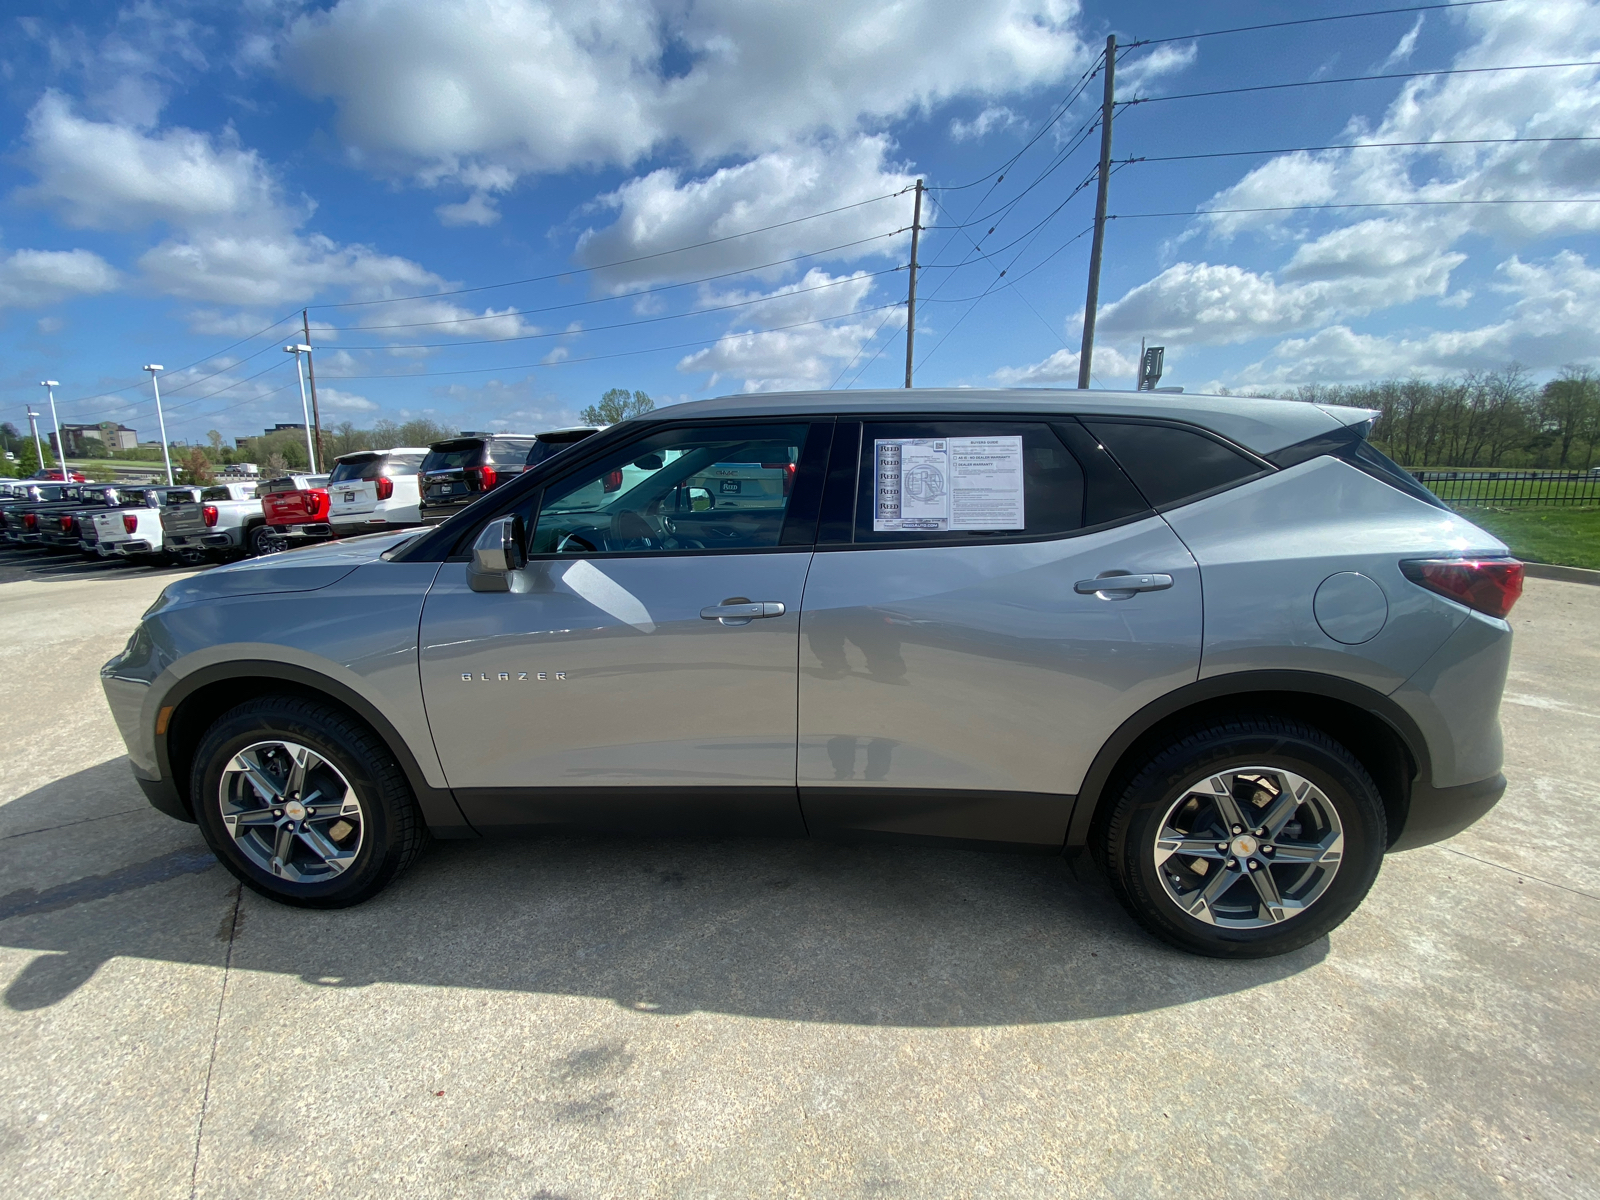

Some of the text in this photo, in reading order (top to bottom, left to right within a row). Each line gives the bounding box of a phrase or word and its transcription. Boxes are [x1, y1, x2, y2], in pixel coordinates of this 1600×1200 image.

[461, 672, 567, 681] BLAZER
[288, 721, 348, 758] KELLY
[1129, 858, 1149, 904] TOURING
